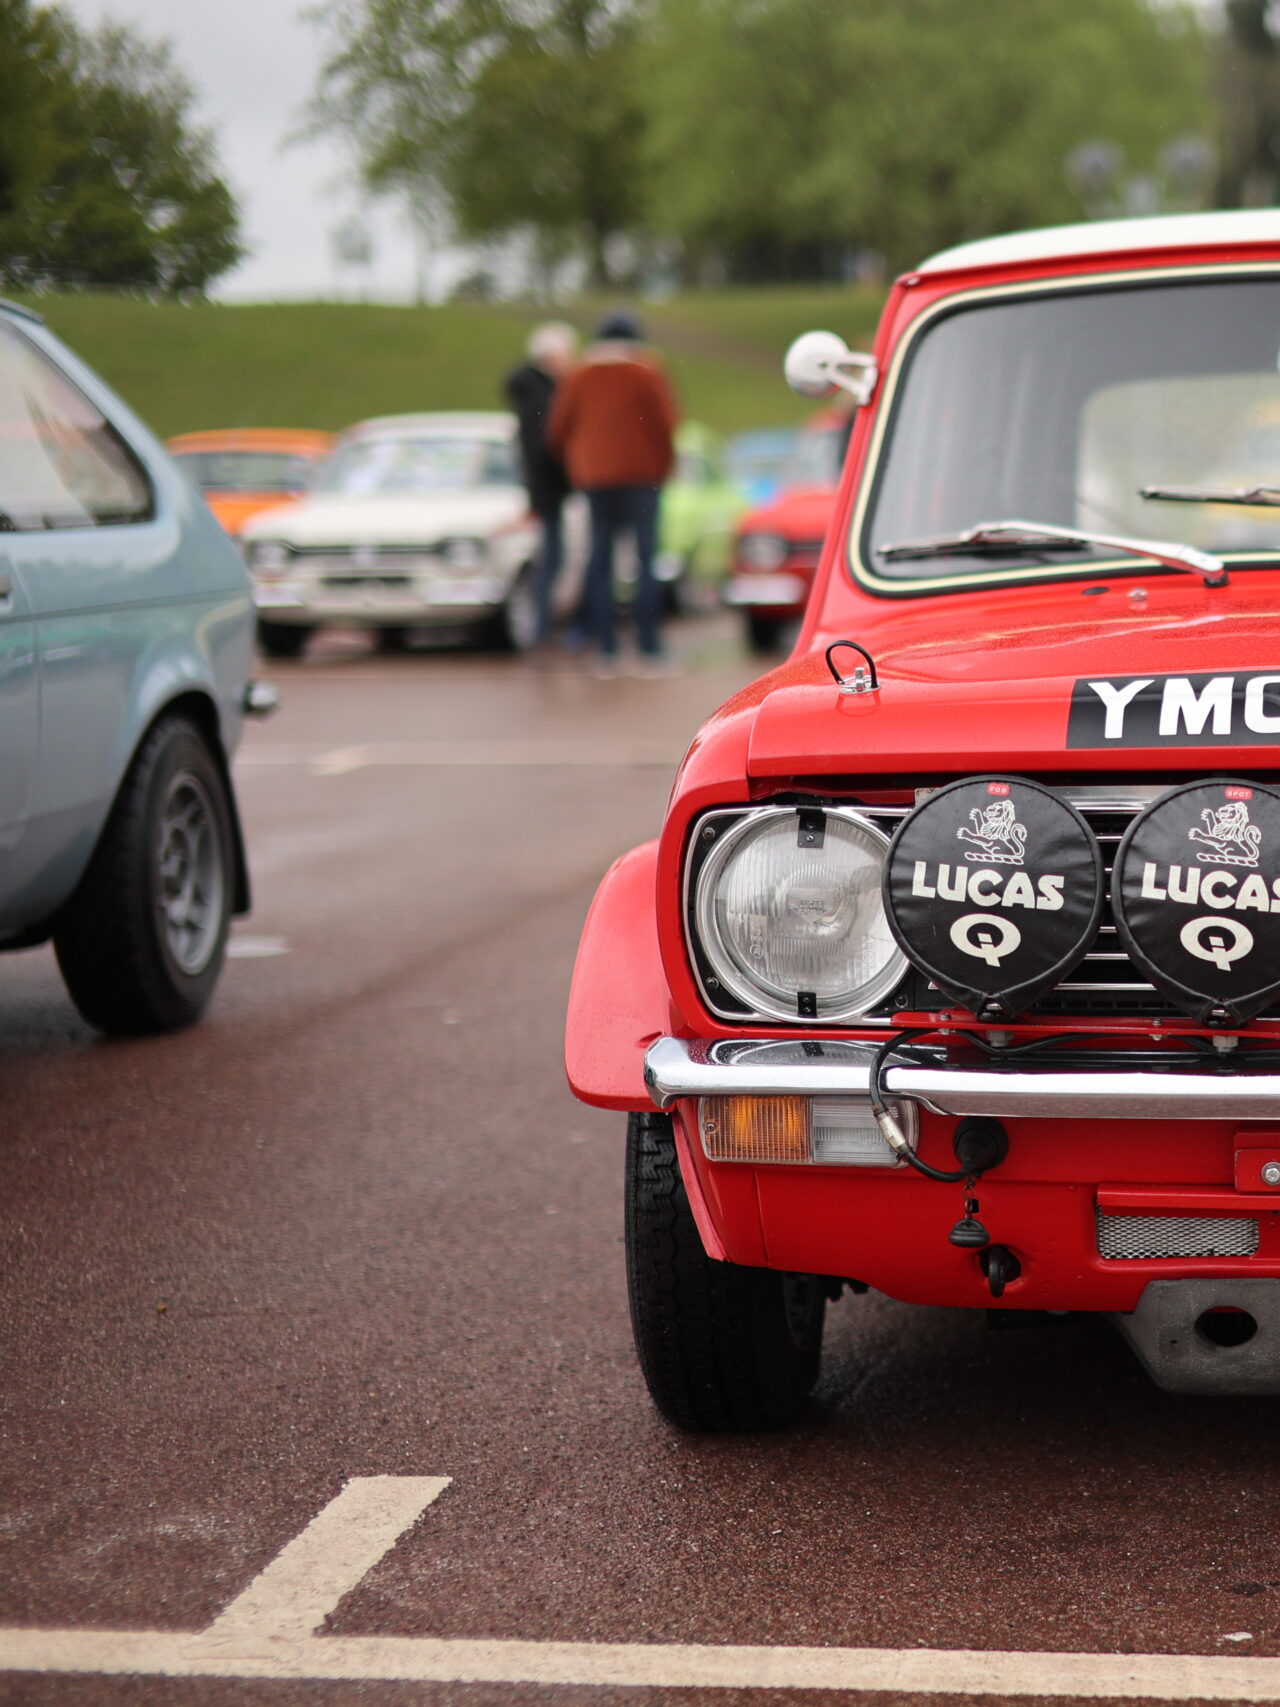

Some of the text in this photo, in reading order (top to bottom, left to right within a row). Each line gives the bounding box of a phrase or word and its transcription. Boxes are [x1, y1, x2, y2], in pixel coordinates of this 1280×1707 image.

[912, 861, 1064, 910] LUCAS
[950, 914, 1021, 967] Q
[1180, 917, 1253, 971] Q
